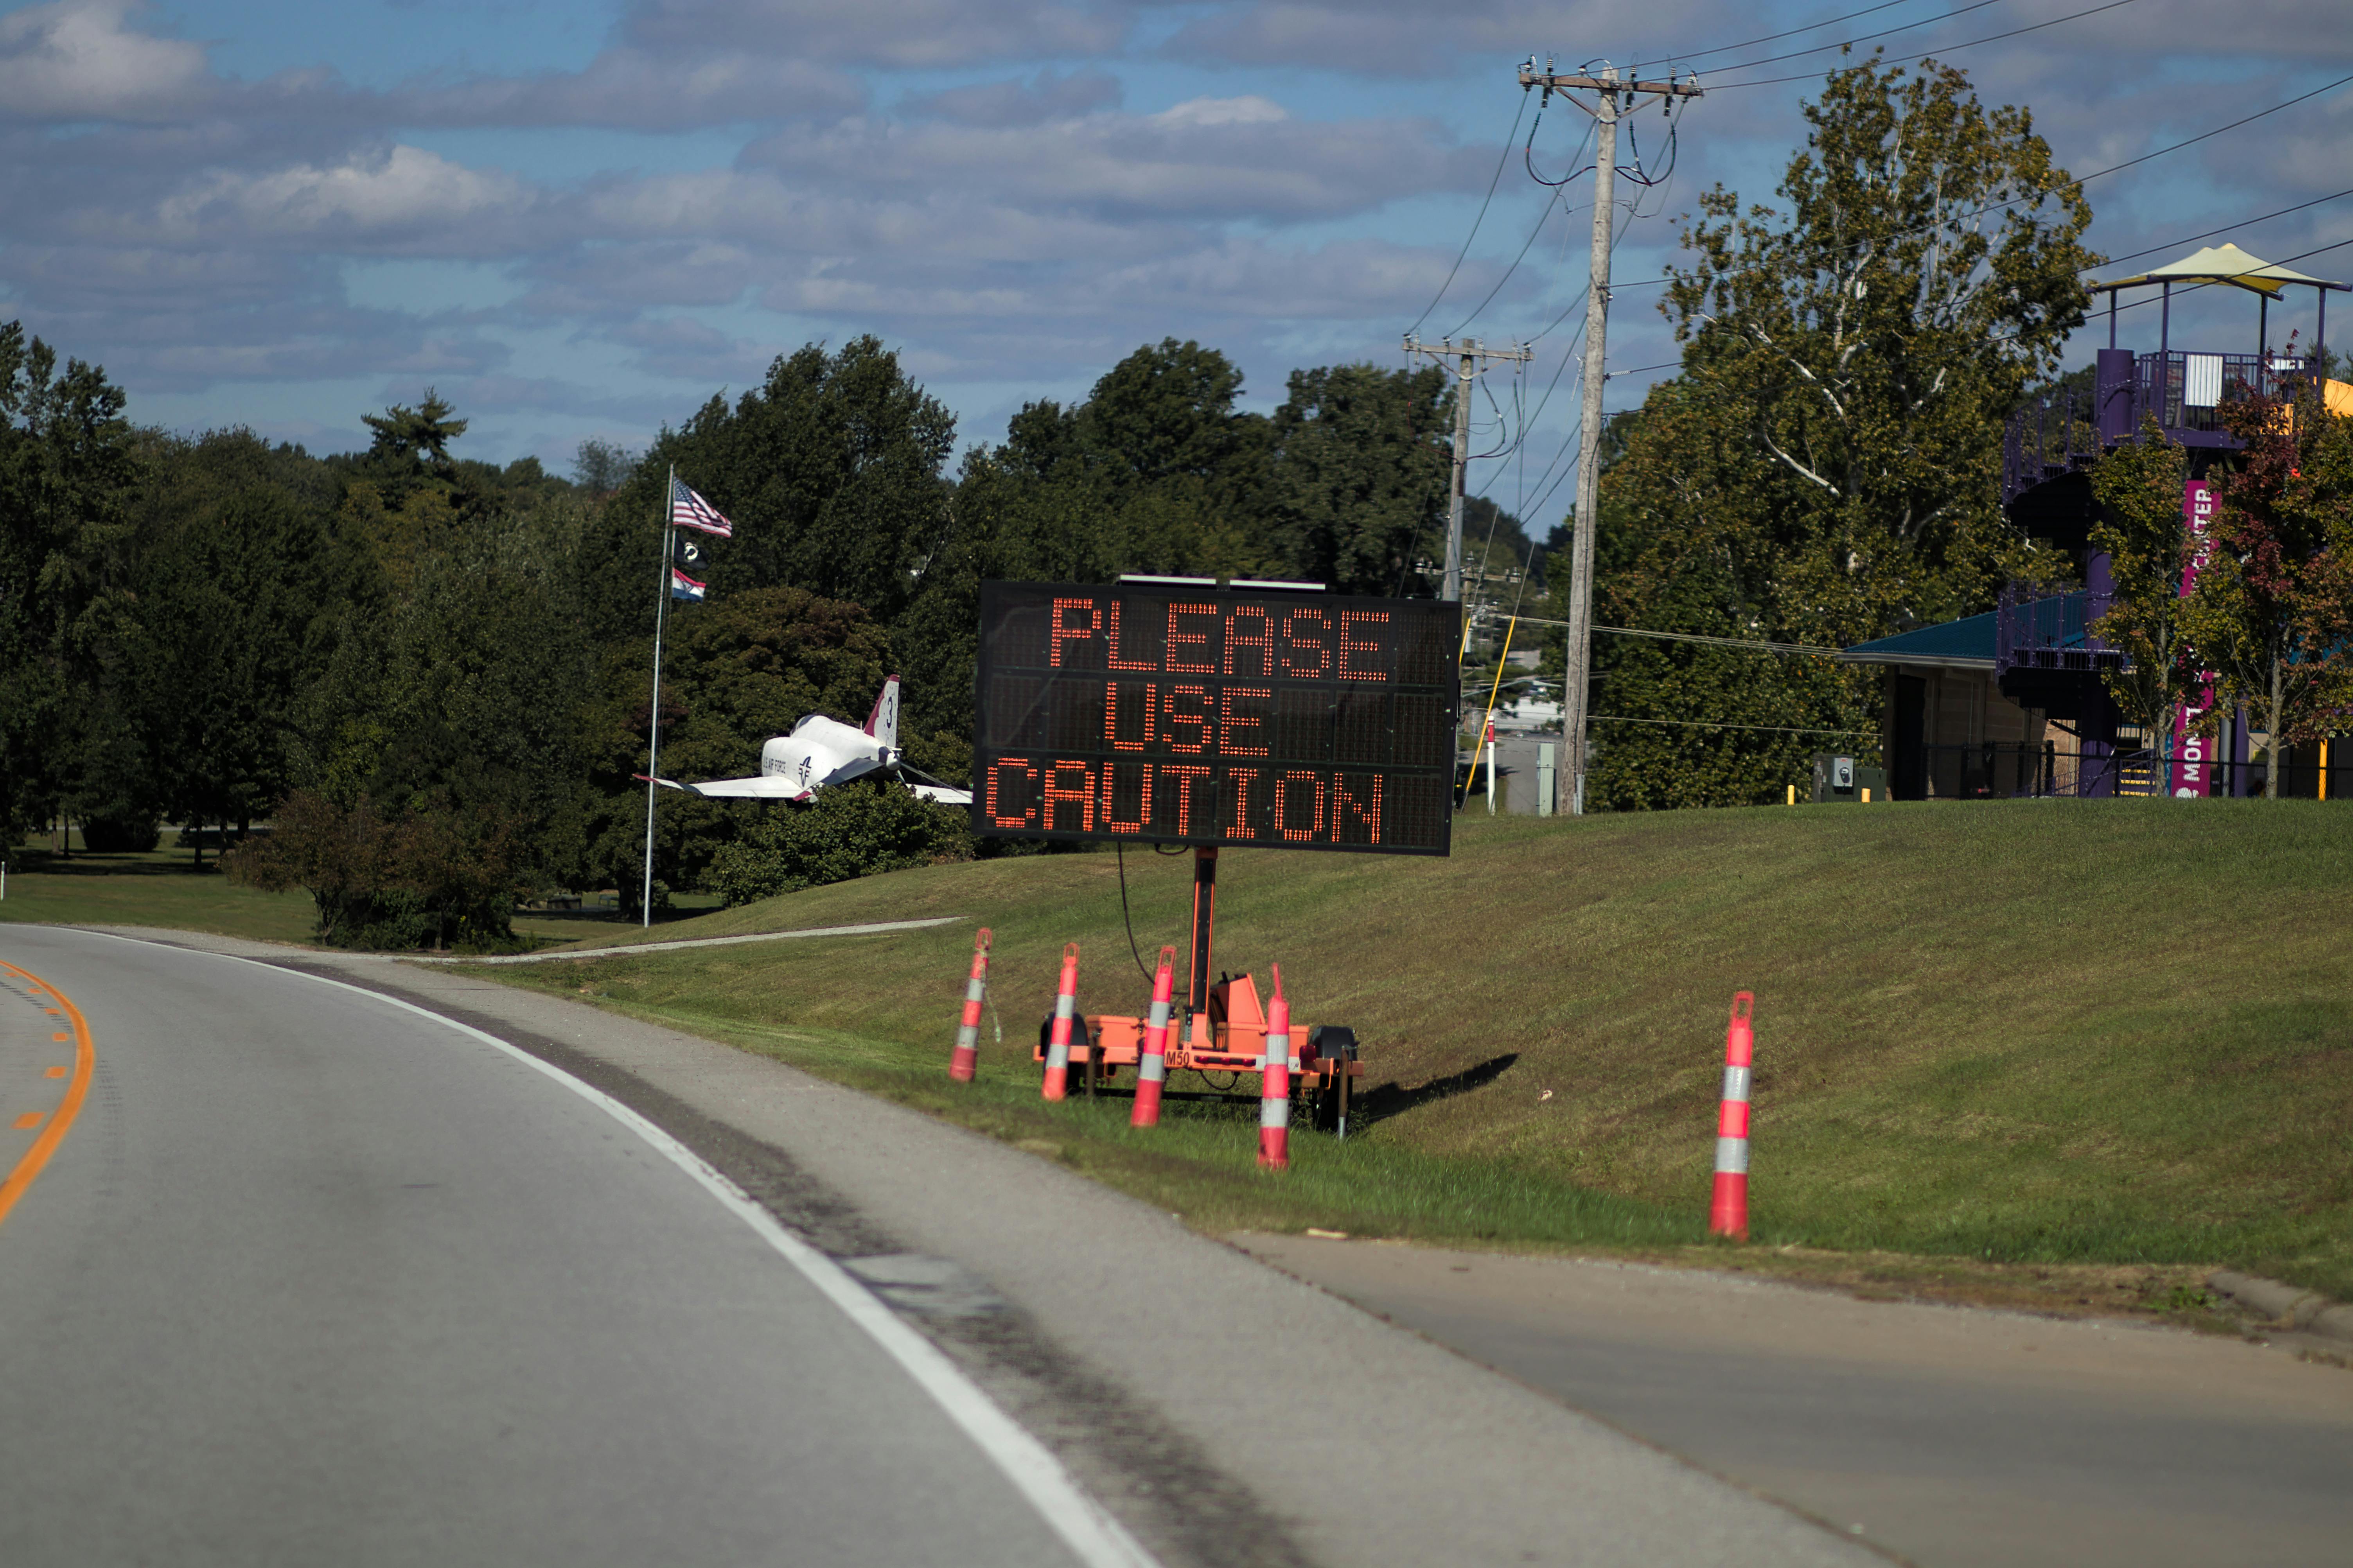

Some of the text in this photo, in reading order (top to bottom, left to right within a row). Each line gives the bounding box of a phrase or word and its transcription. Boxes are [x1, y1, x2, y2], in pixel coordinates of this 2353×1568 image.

[1051, 598, 1389, 682] PLEASE
[887, 696, 893, 728] 3
[1105, 682, 1271, 756] USE
[986, 758, 1383, 843] CAUTION
[1166, 1051, 1189, 1065] M50
